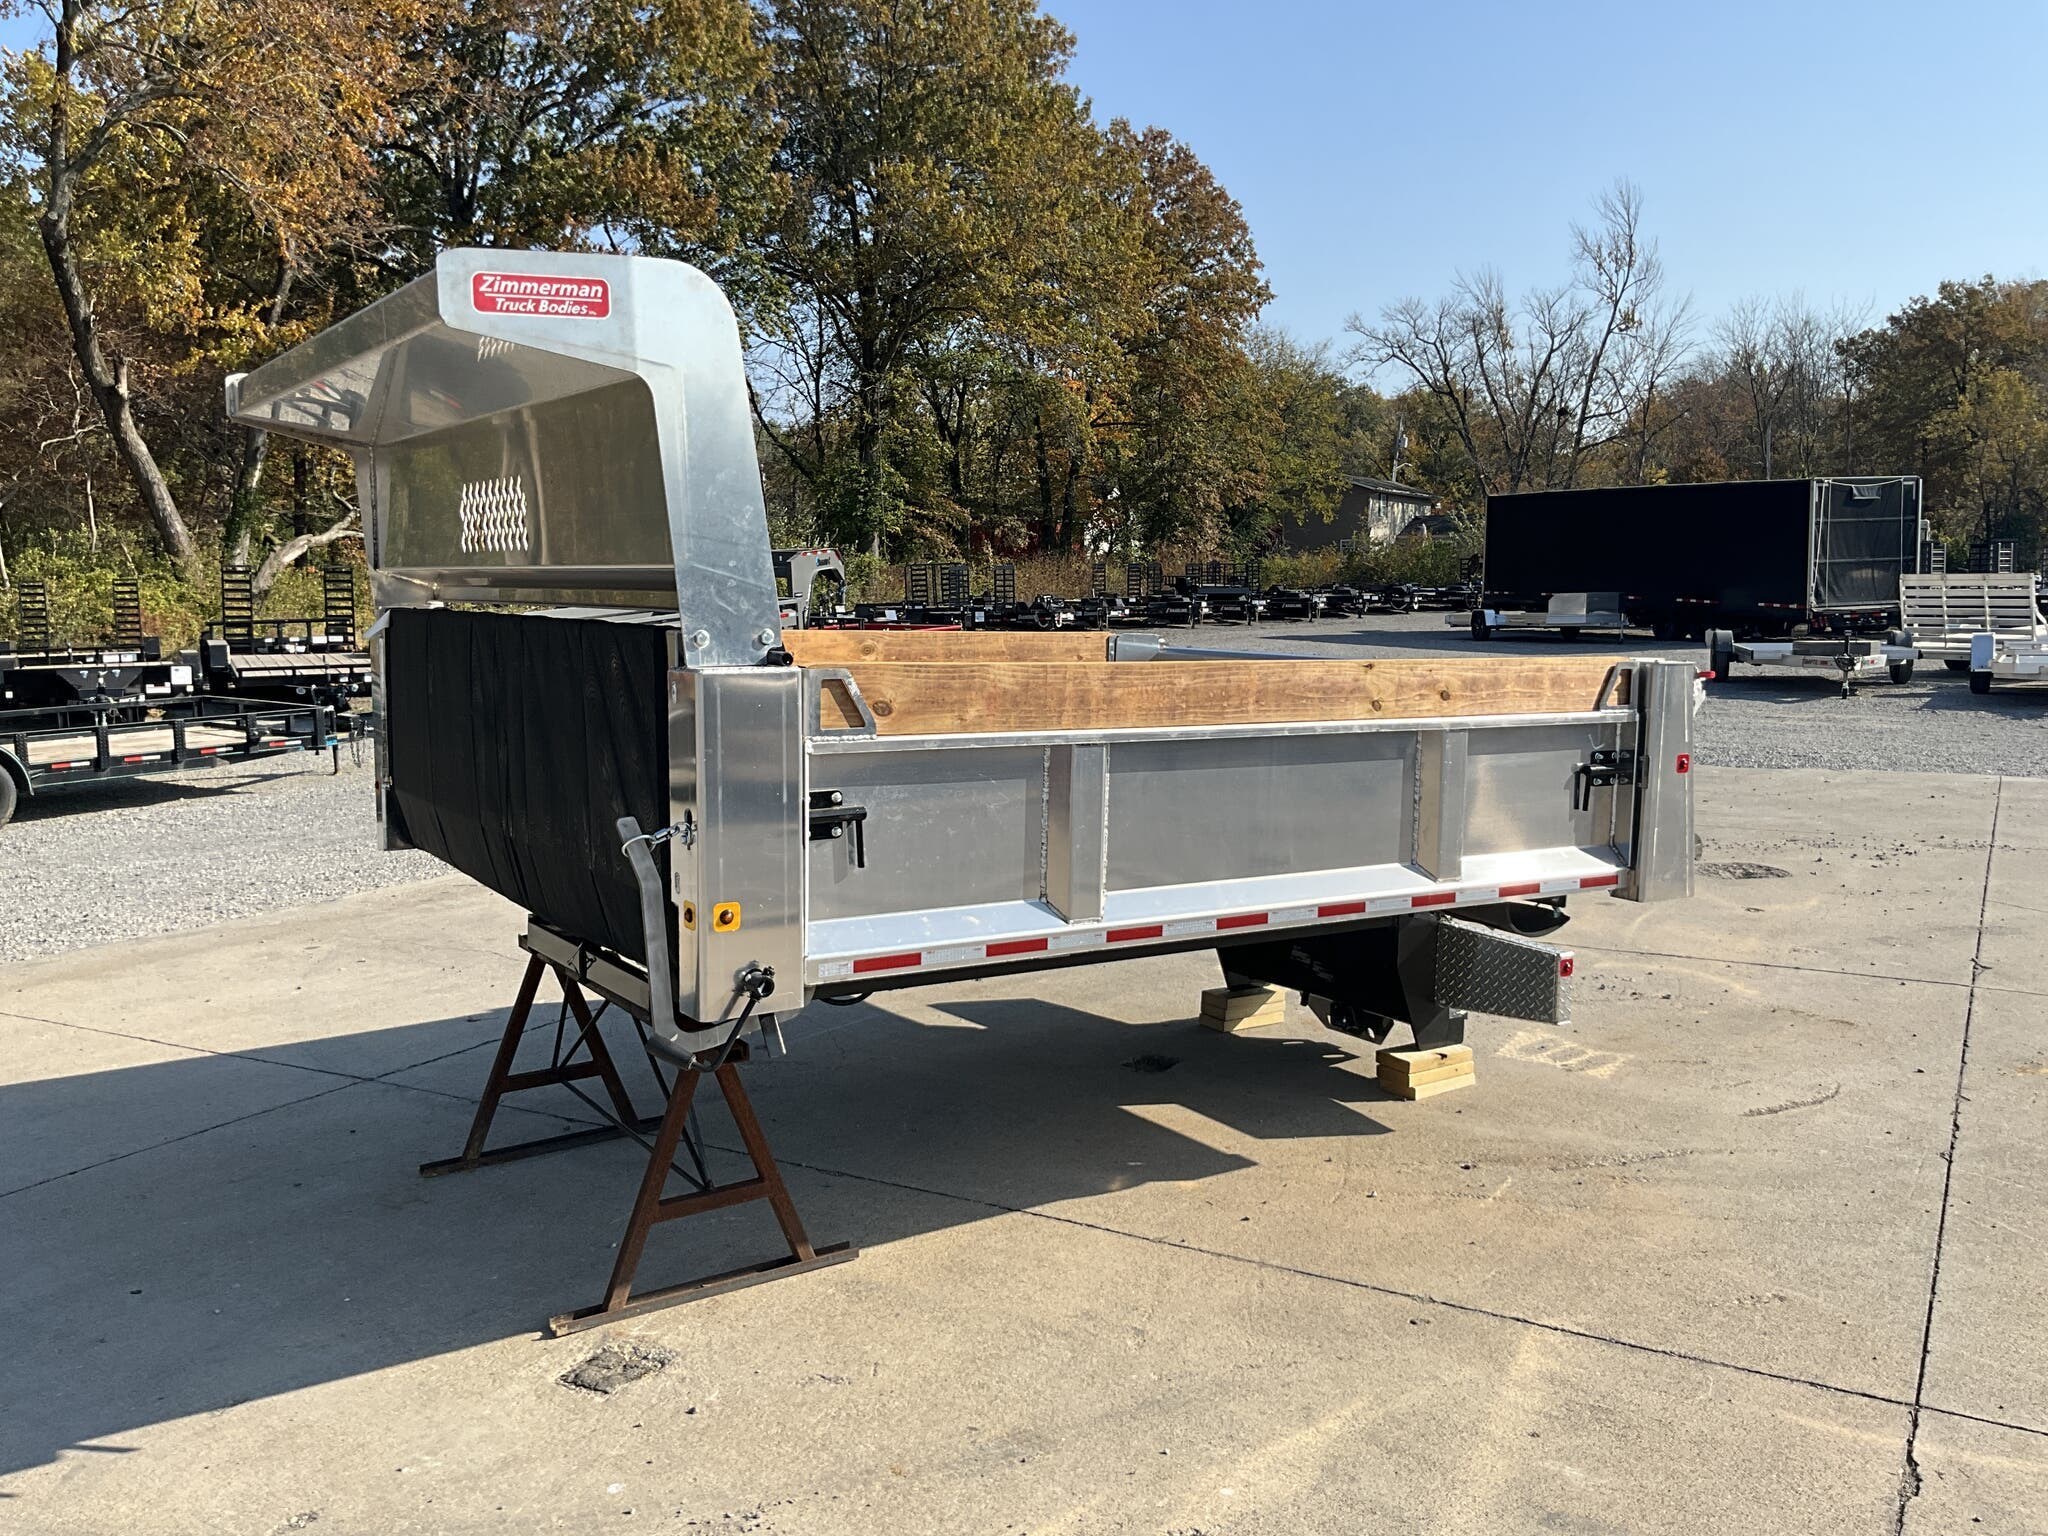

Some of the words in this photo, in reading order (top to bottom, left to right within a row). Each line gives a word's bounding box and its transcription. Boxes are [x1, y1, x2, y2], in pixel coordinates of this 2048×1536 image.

[479, 275, 603, 298] Zimmerman
[495, 298, 536, 313] Truck
[538, 300, 588, 315] Bodies
